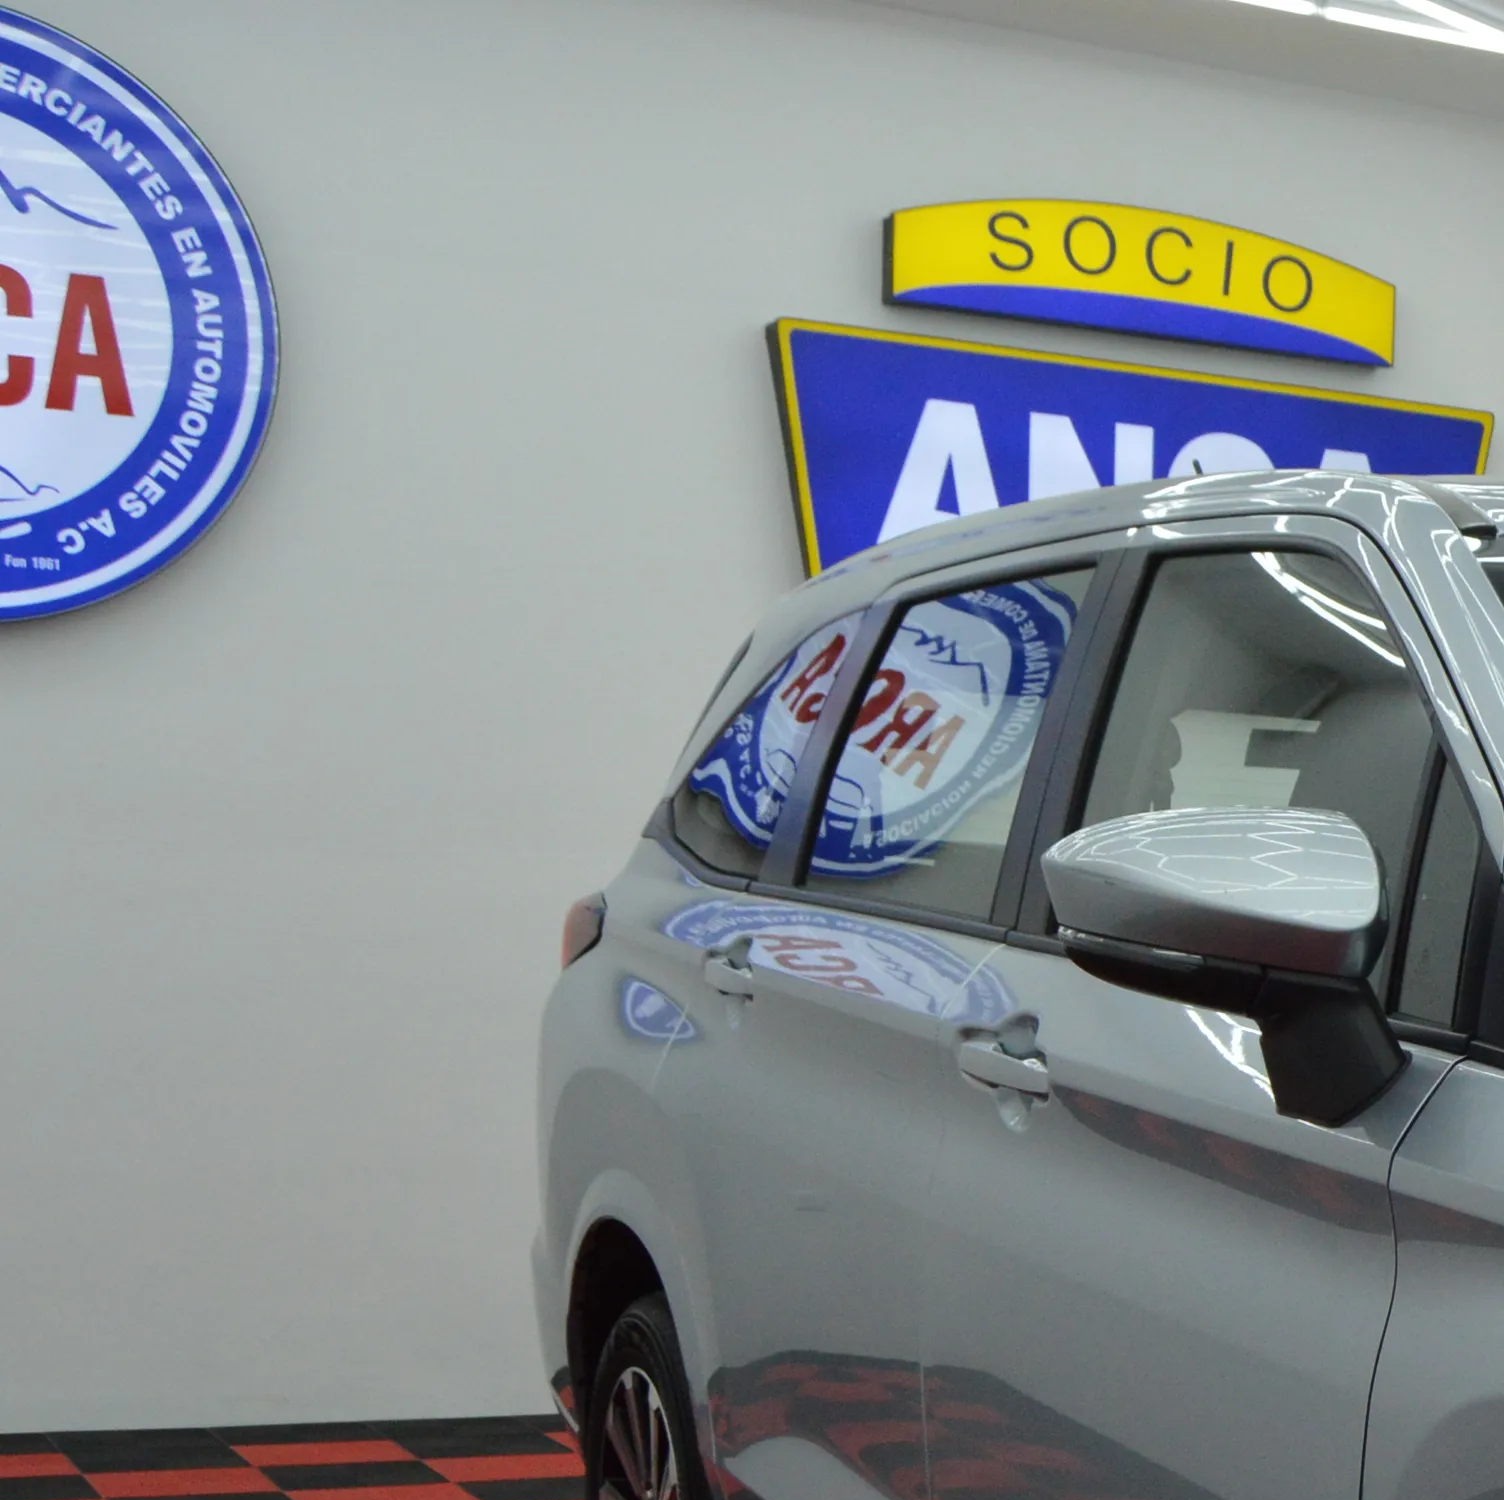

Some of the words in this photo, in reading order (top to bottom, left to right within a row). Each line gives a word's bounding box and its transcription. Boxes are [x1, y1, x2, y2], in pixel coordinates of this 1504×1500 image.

[171, 226, 213, 278] EN
[987, 210, 1313, 313] SOCIO
[118, 287, 223, 519] AUTOMOVILES
